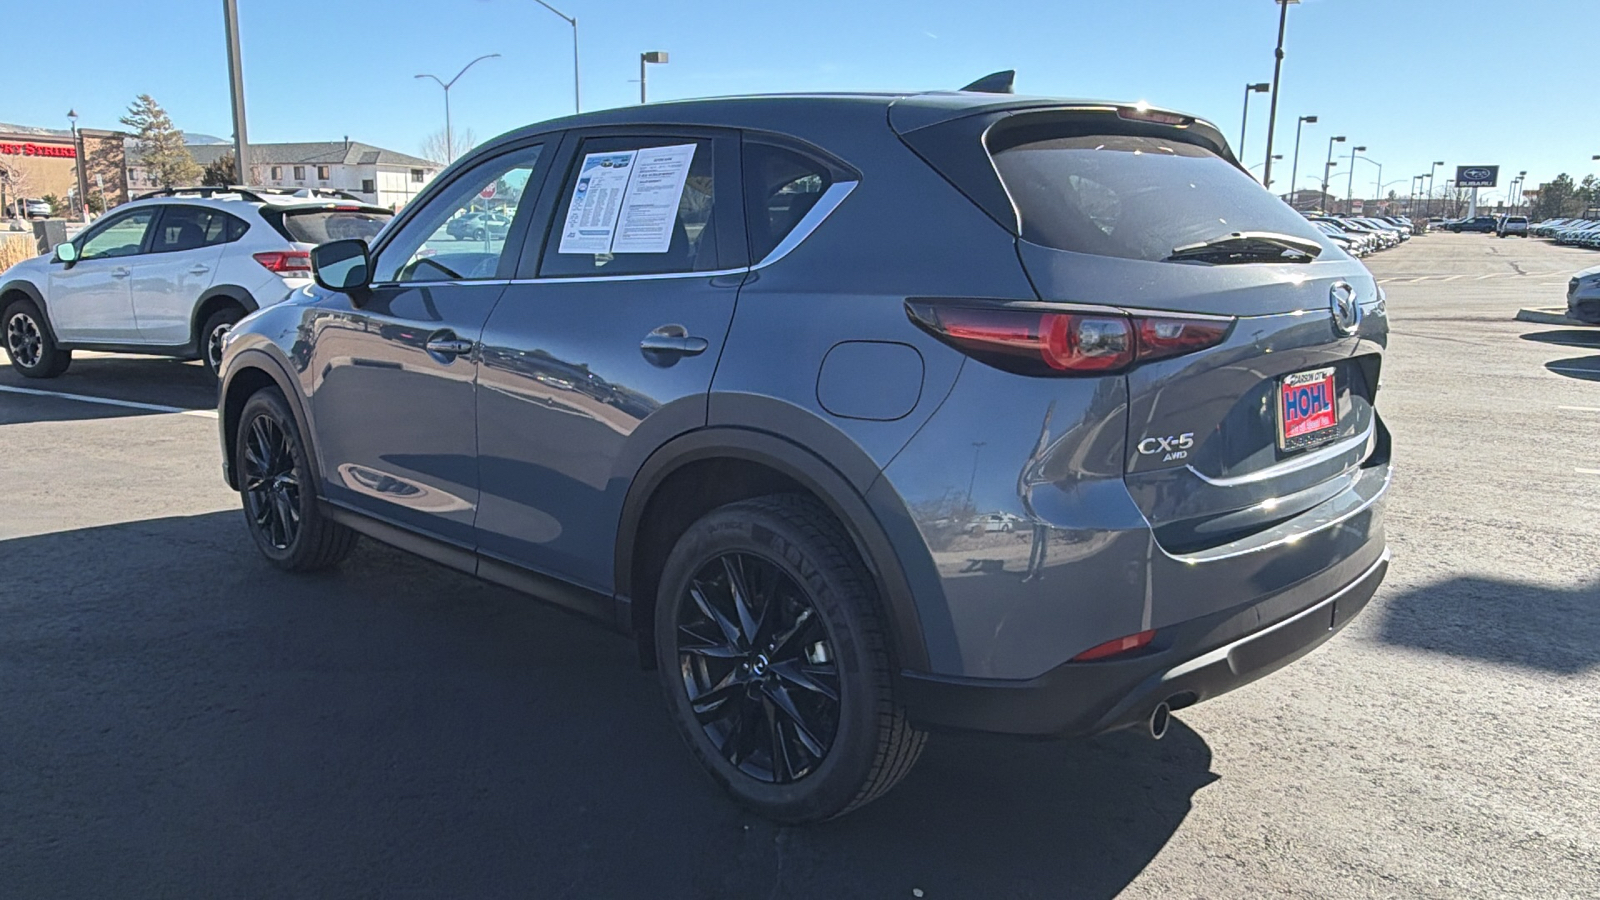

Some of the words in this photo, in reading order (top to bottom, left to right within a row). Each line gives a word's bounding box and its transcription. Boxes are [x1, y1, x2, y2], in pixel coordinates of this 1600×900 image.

[1285, 383, 1330, 421] HOHL
[1137, 432, 1194, 454] CX-5
[1162, 450, 1188, 462] AWD
